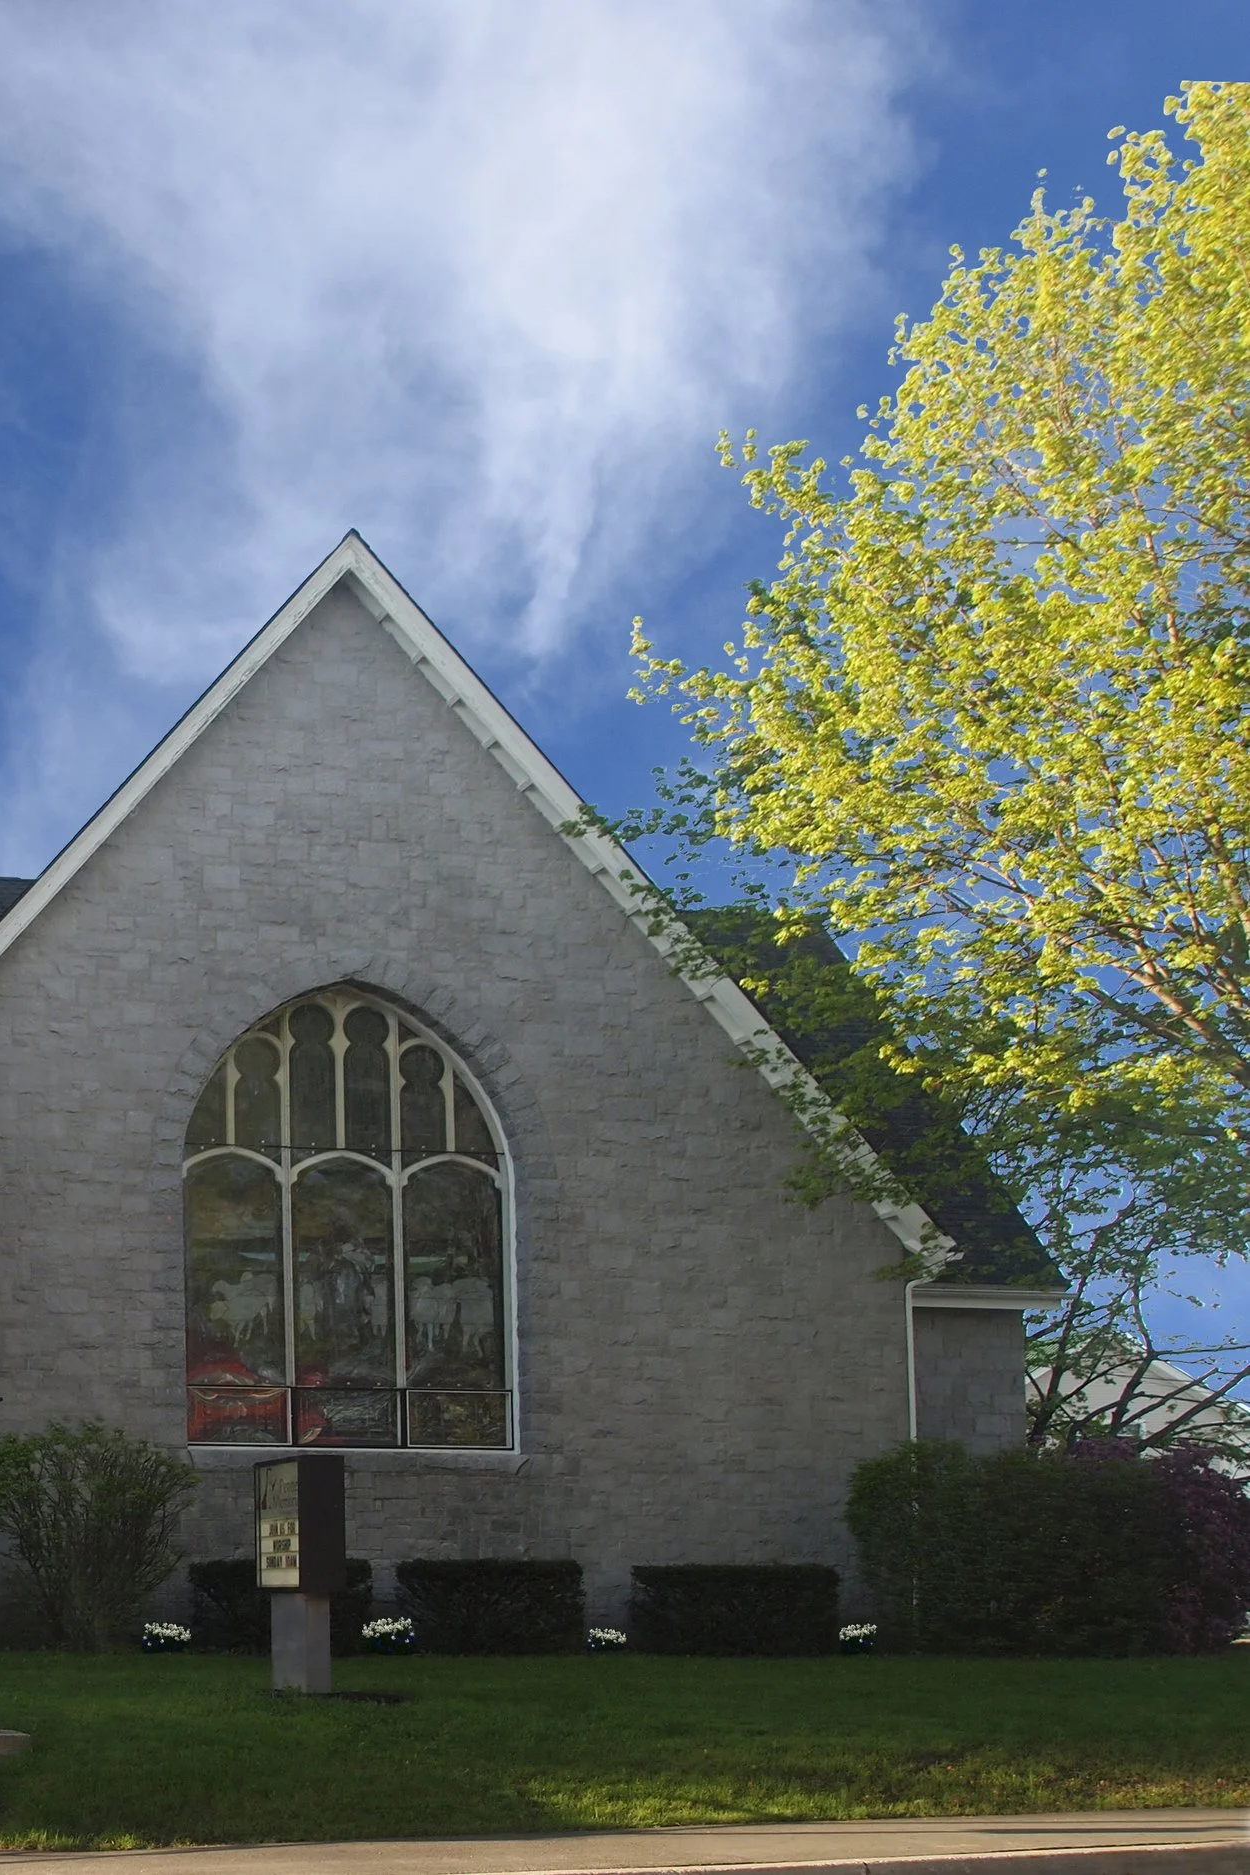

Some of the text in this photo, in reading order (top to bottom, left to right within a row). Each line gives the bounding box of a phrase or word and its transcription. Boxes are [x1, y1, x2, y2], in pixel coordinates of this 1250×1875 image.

[269, 1523, 278, 1536] JOIN
[288, 1521, 296, 1535] FOR
[273, 1538, 291, 1552] WORSHIP
[266, 1555, 282, 1568] SUNDAY
